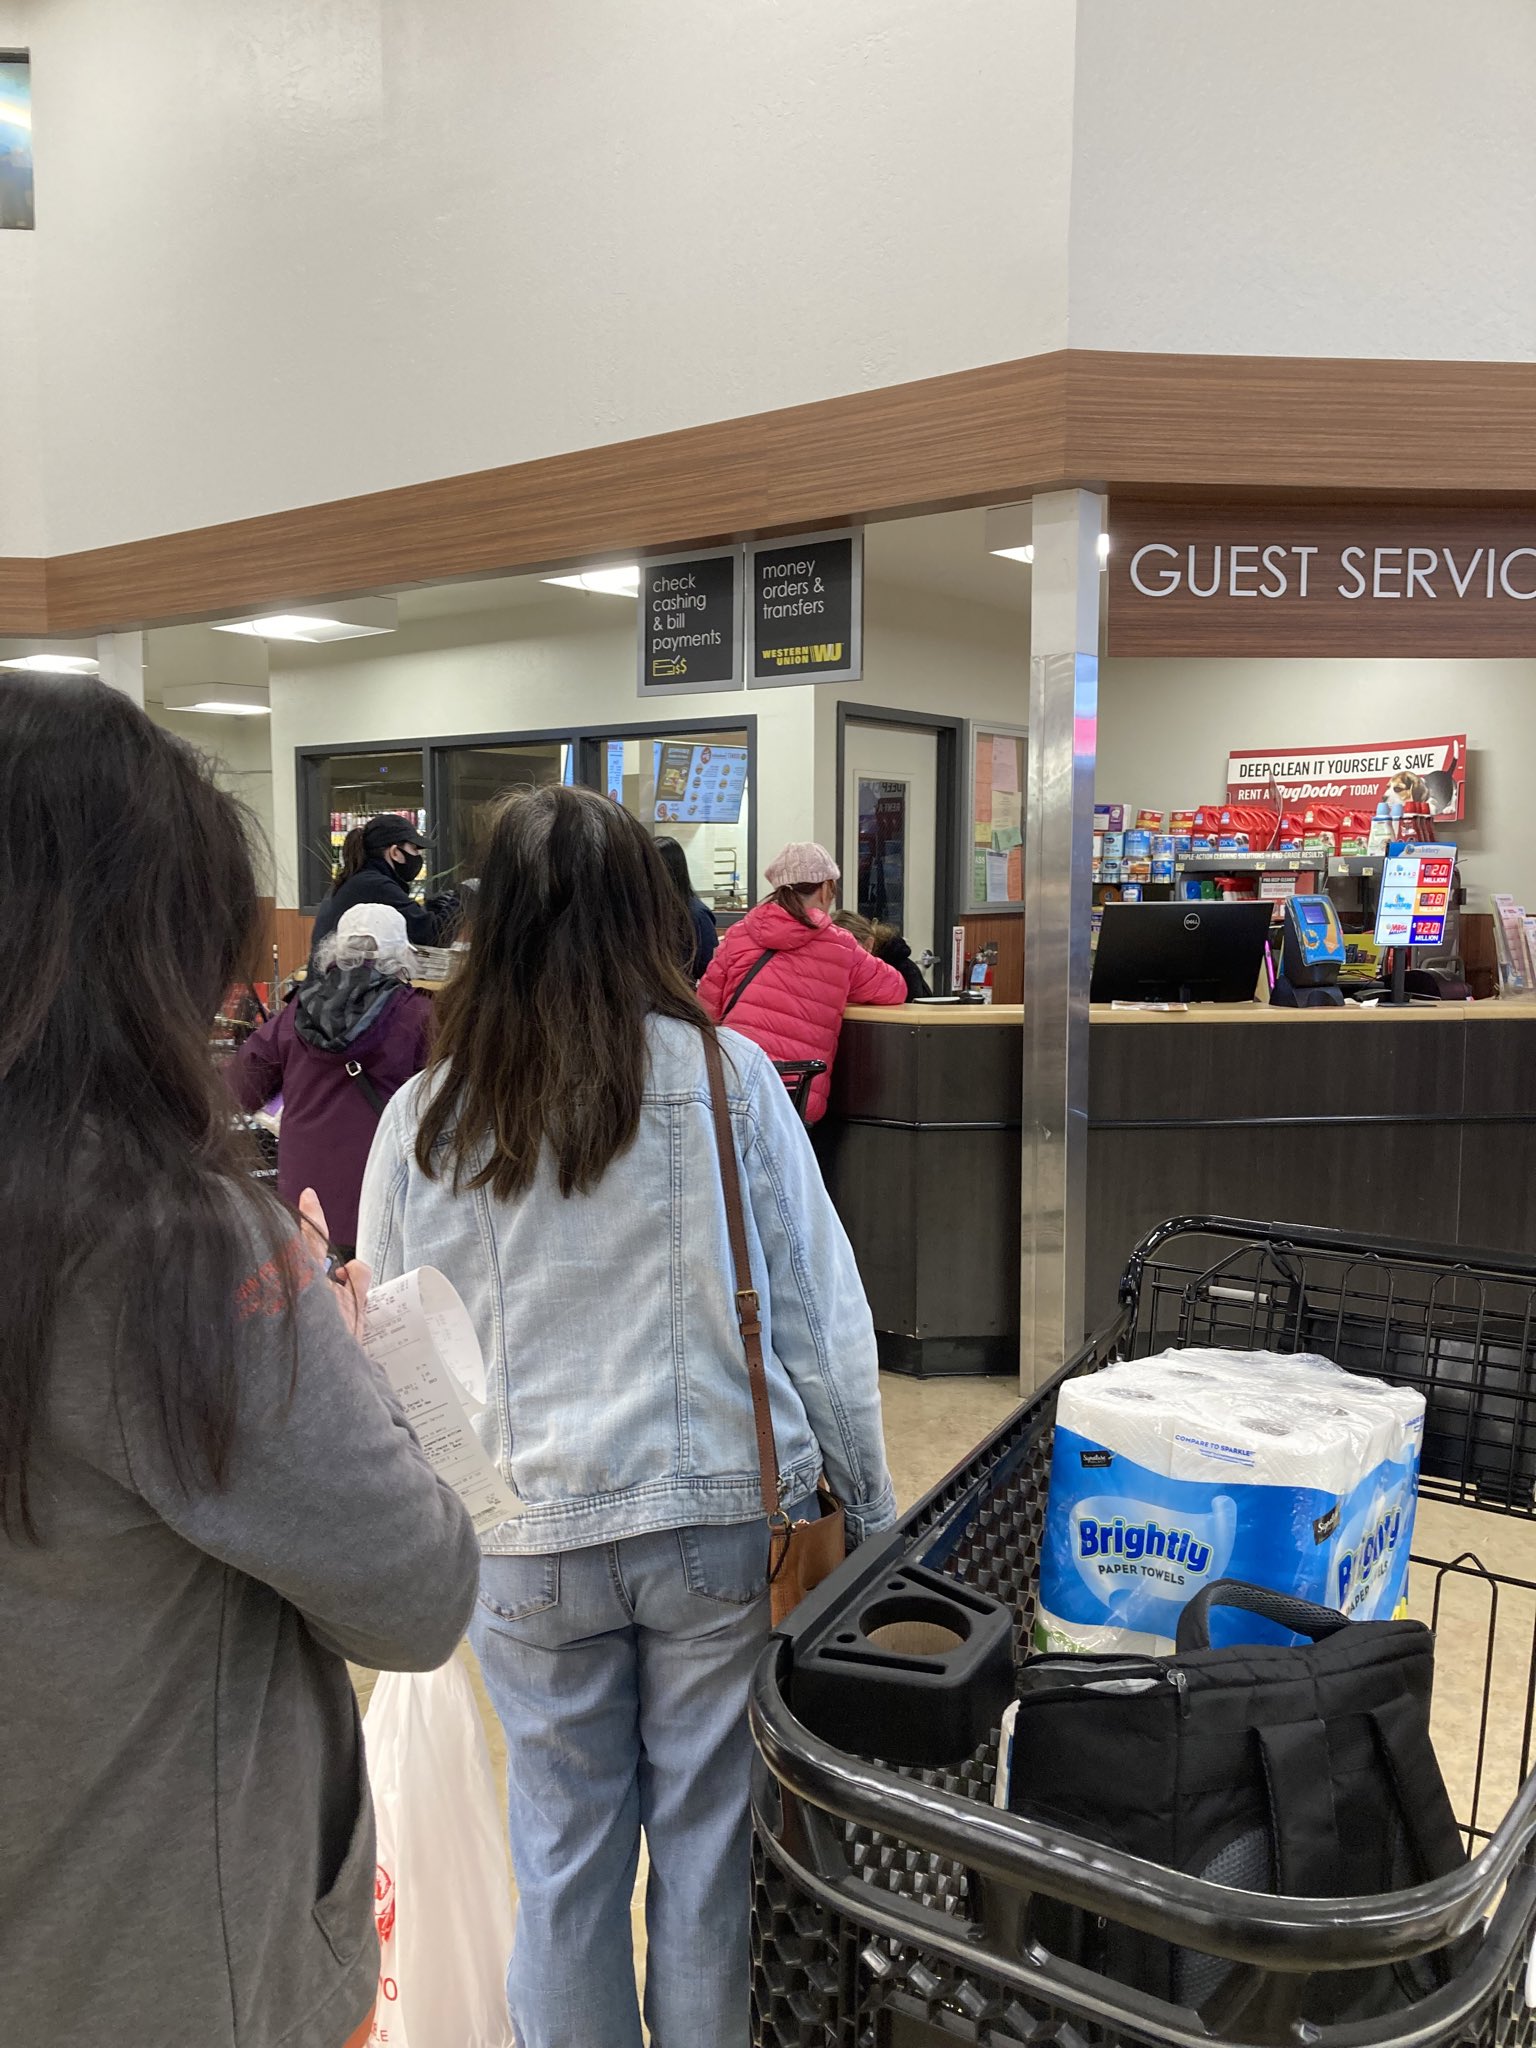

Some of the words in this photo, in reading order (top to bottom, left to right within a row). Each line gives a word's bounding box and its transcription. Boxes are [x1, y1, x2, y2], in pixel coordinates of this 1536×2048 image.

[763, 560, 816, 580] money
[1130, 543, 1318, 598] GUEST
[1338, 546, 1536, 600] SERVIC
[652, 573, 696, 593] check
[763, 580, 809, 599] orders
[813, 577, 825, 593] &
[652, 592, 707, 612] cashing
[763, 599, 825, 620] transfers
[653, 616, 664, 631] &
[666, 612, 686, 630] bill
[652, 629, 722, 654] payments
[762, 646, 809, 659] WESTERN
[776, 655, 809, 666] UNION
[1239, 763, 1271, 778] DEEP
[1272, 761, 1310, 776] CLEAN
[1314, 760, 1325, 775] IT
[1327, 757, 1390, 774] YOURSELF
[1392, 755, 1402, 770] &
[1405, 753, 1435, 769] SAVE
[1238, 788, 1262, 800] RENT
[1263, 787, 1270, 799] A
[1275, 783, 1348, 803] RugDoctor
[1349, 783, 1379, 796] TODAY
[1301, 851, 1324, 859] RESULTS
[1174, 1434, 1209, 1449] COMPARE
[1210, 1441, 1220, 1450] TO
[1078, 1518, 1211, 1573] Brightly
[1098, 1563, 1138, 1577] PAPER
[1140, 1566, 1186, 1586] TOWELS
